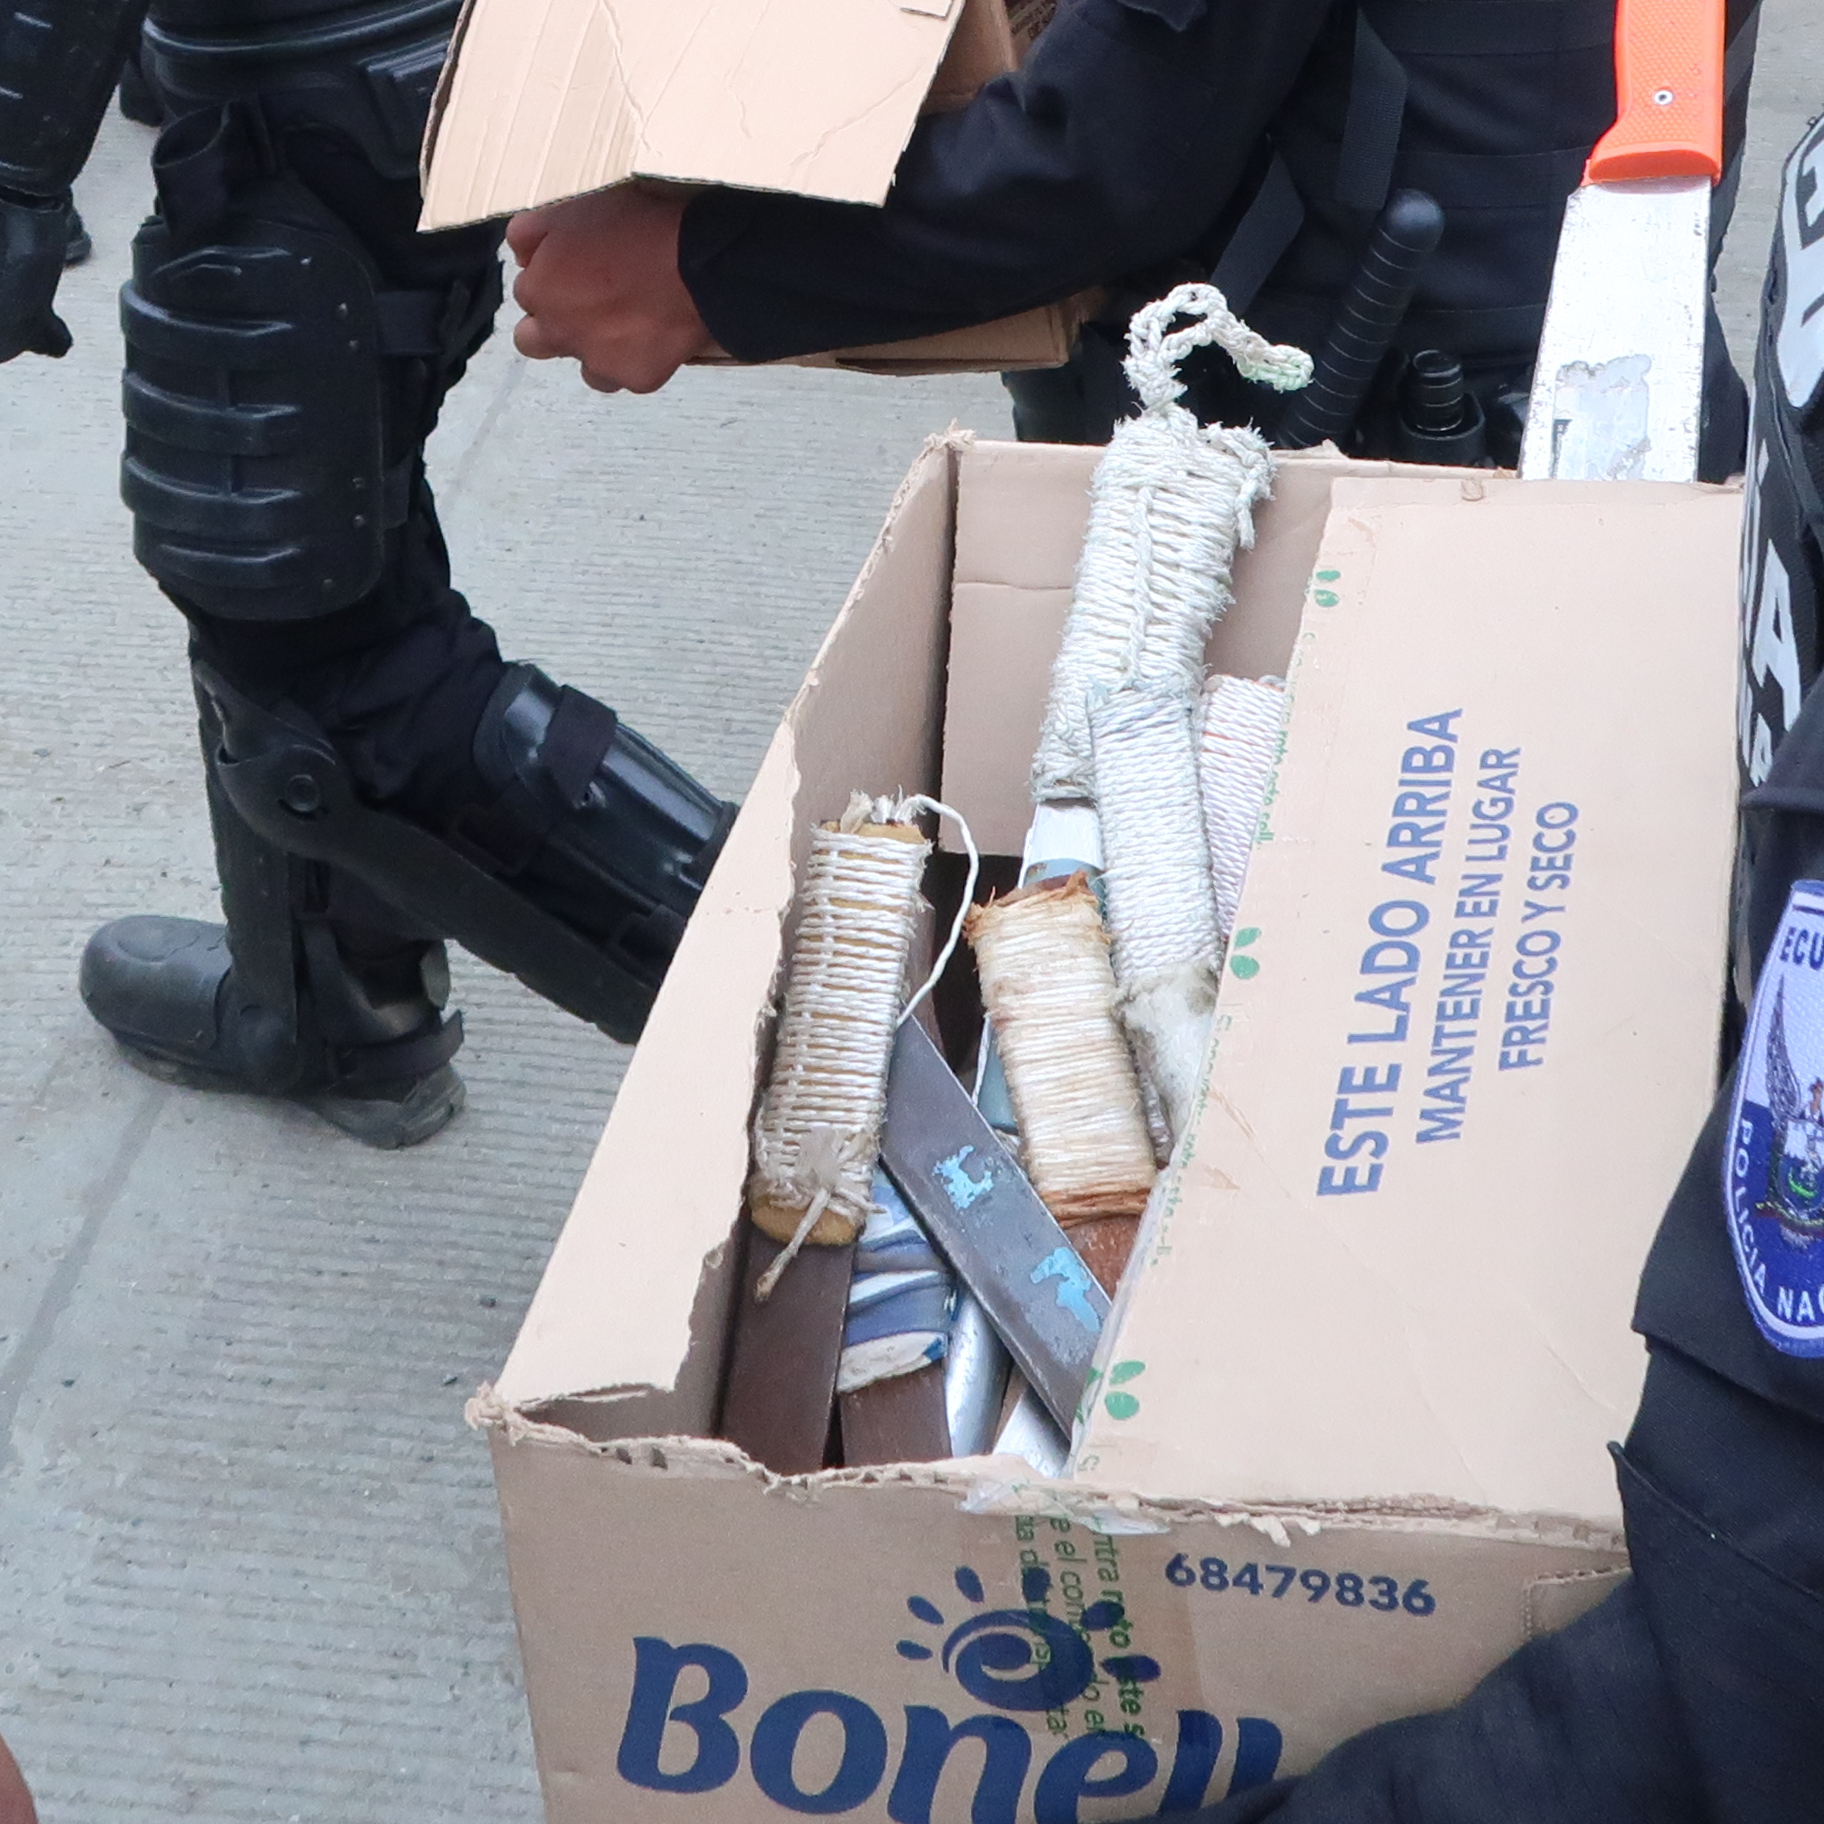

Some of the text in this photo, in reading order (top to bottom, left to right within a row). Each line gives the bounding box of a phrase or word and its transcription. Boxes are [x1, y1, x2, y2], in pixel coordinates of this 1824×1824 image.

[1316, 707, 1464, 1198] ESTE LADO ARRIBA
[1415, 746, 1521, 1144] MANTENER EN LUGAR
[1498, 800, 1579, 1071] FRESCO Y SECO
[1734, 1118, 1768, 1296] POLICIA
[1164, 1551, 1438, 1618] 68479836
